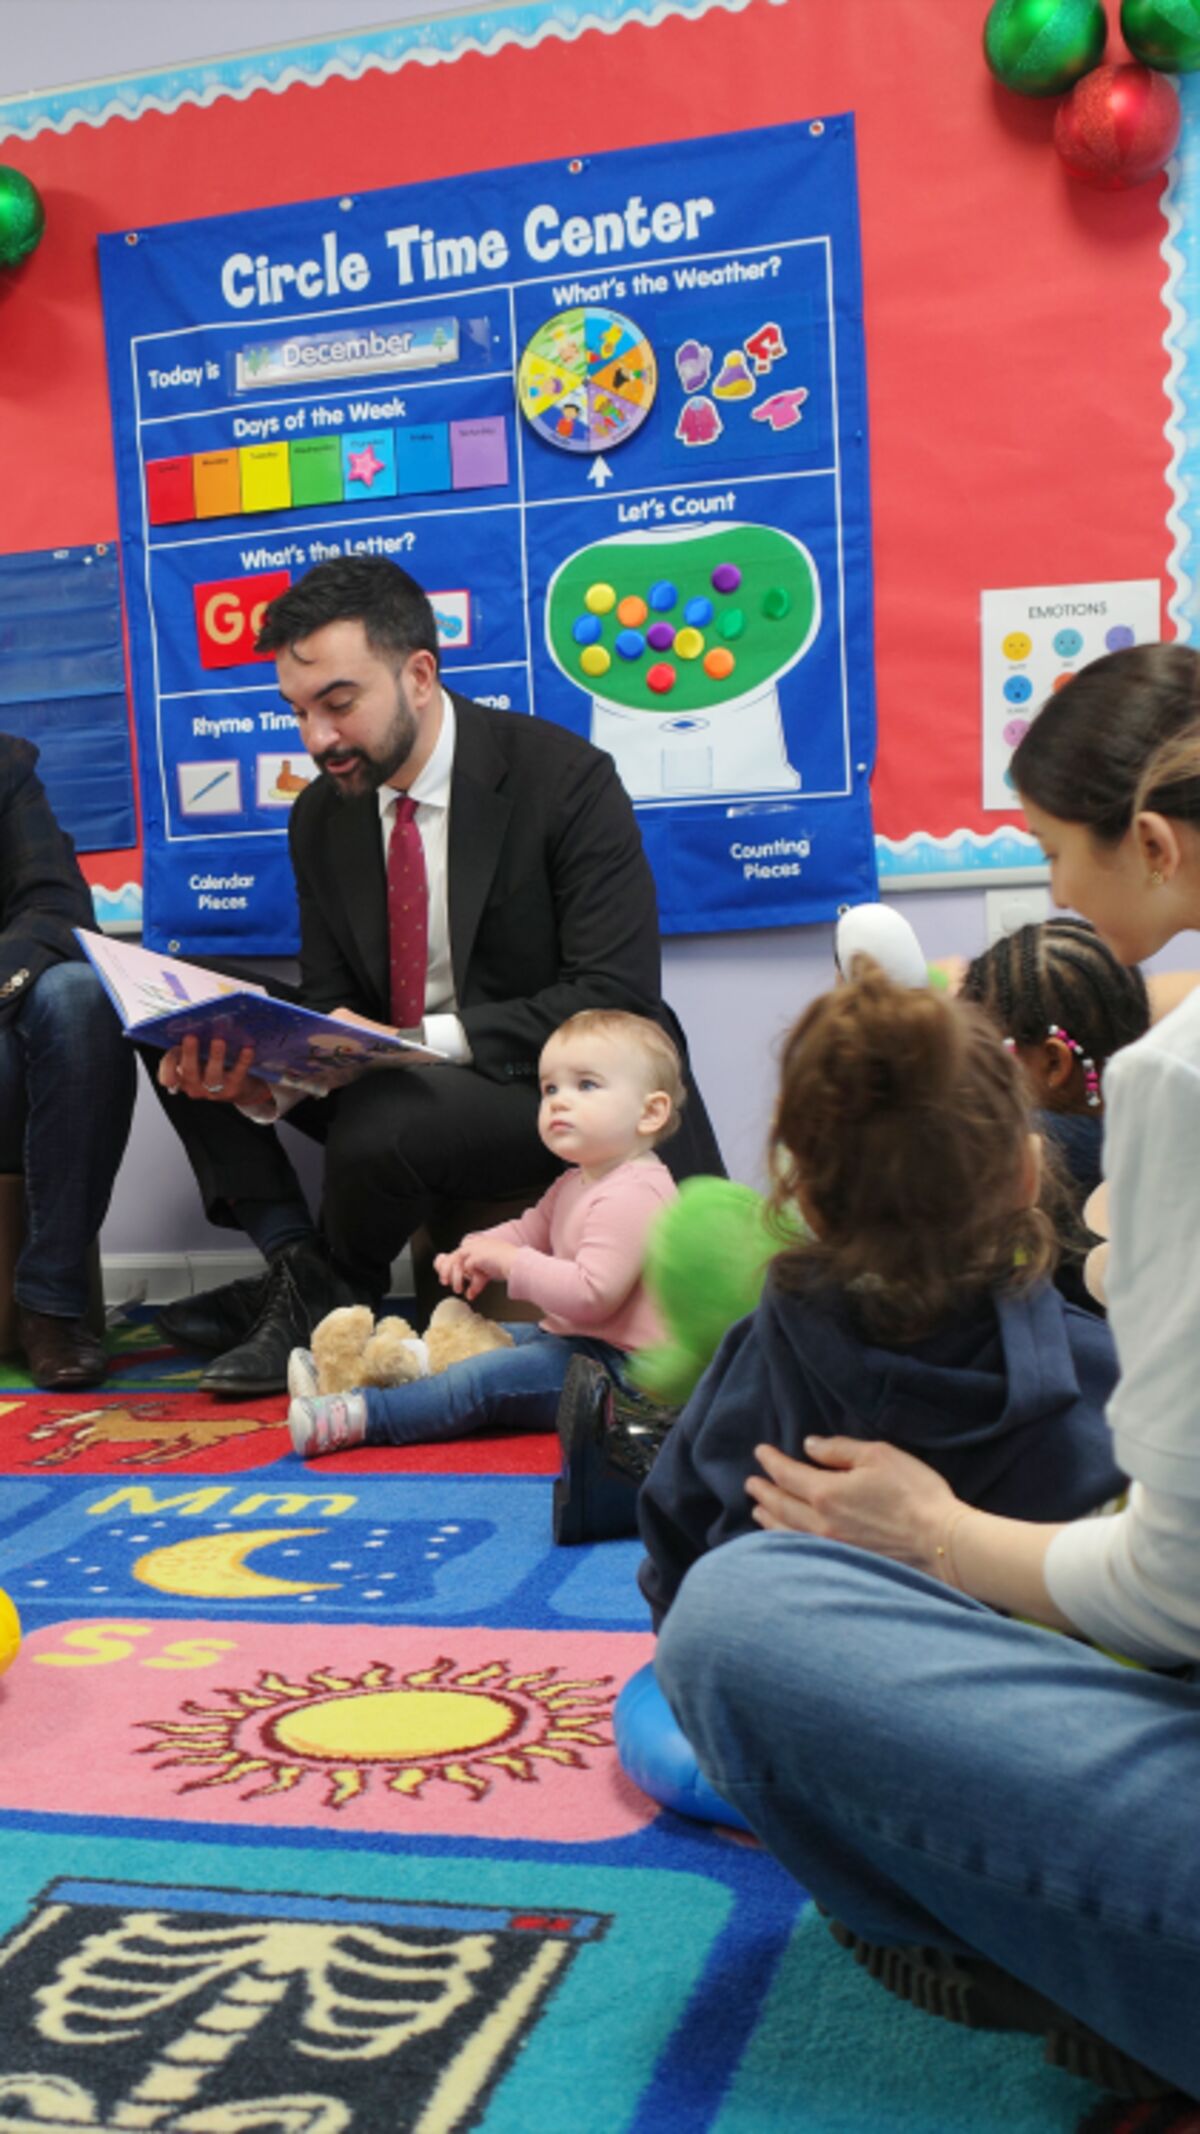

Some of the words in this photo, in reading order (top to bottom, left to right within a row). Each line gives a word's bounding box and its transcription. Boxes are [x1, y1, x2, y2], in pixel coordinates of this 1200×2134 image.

[221, 231, 371, 308] Circle
[386, 224, 509, 285] Time
[523, 196, 715, 262] Center
[552, 278, 627, 307] What's
[632, 273, 669, 294] the
[673, 256, 783, 290] Weather?
[148, 363, 203, 388] Today
[206, 361, 220, 380] is
[281, 330, 414, 366] December
[233, 416, 280, 438] Days
[284, 408, 305, 430] of
[311, 405, 344, 427] the
[346, 398, 406, 423] Week
[618, 499, 666, 523] Let's
[670, 492, 737, 518] Count
[240, 545, 305, 571] What's
[309, 541, 341, 562] the
[1028, 601, 1108, 619] EMOTIONS
[192, 716, 255, 738] Rhyme
[730, 839, 811, 859] Counting
[189, 873, 255, 891] Calendar
[743, 862, 802, 880] Pieces
[198, 894, 248, 911] Pieces
[86, 1486, 358, 1516] Mm
[32, 1624, 239, 1671] Ss
